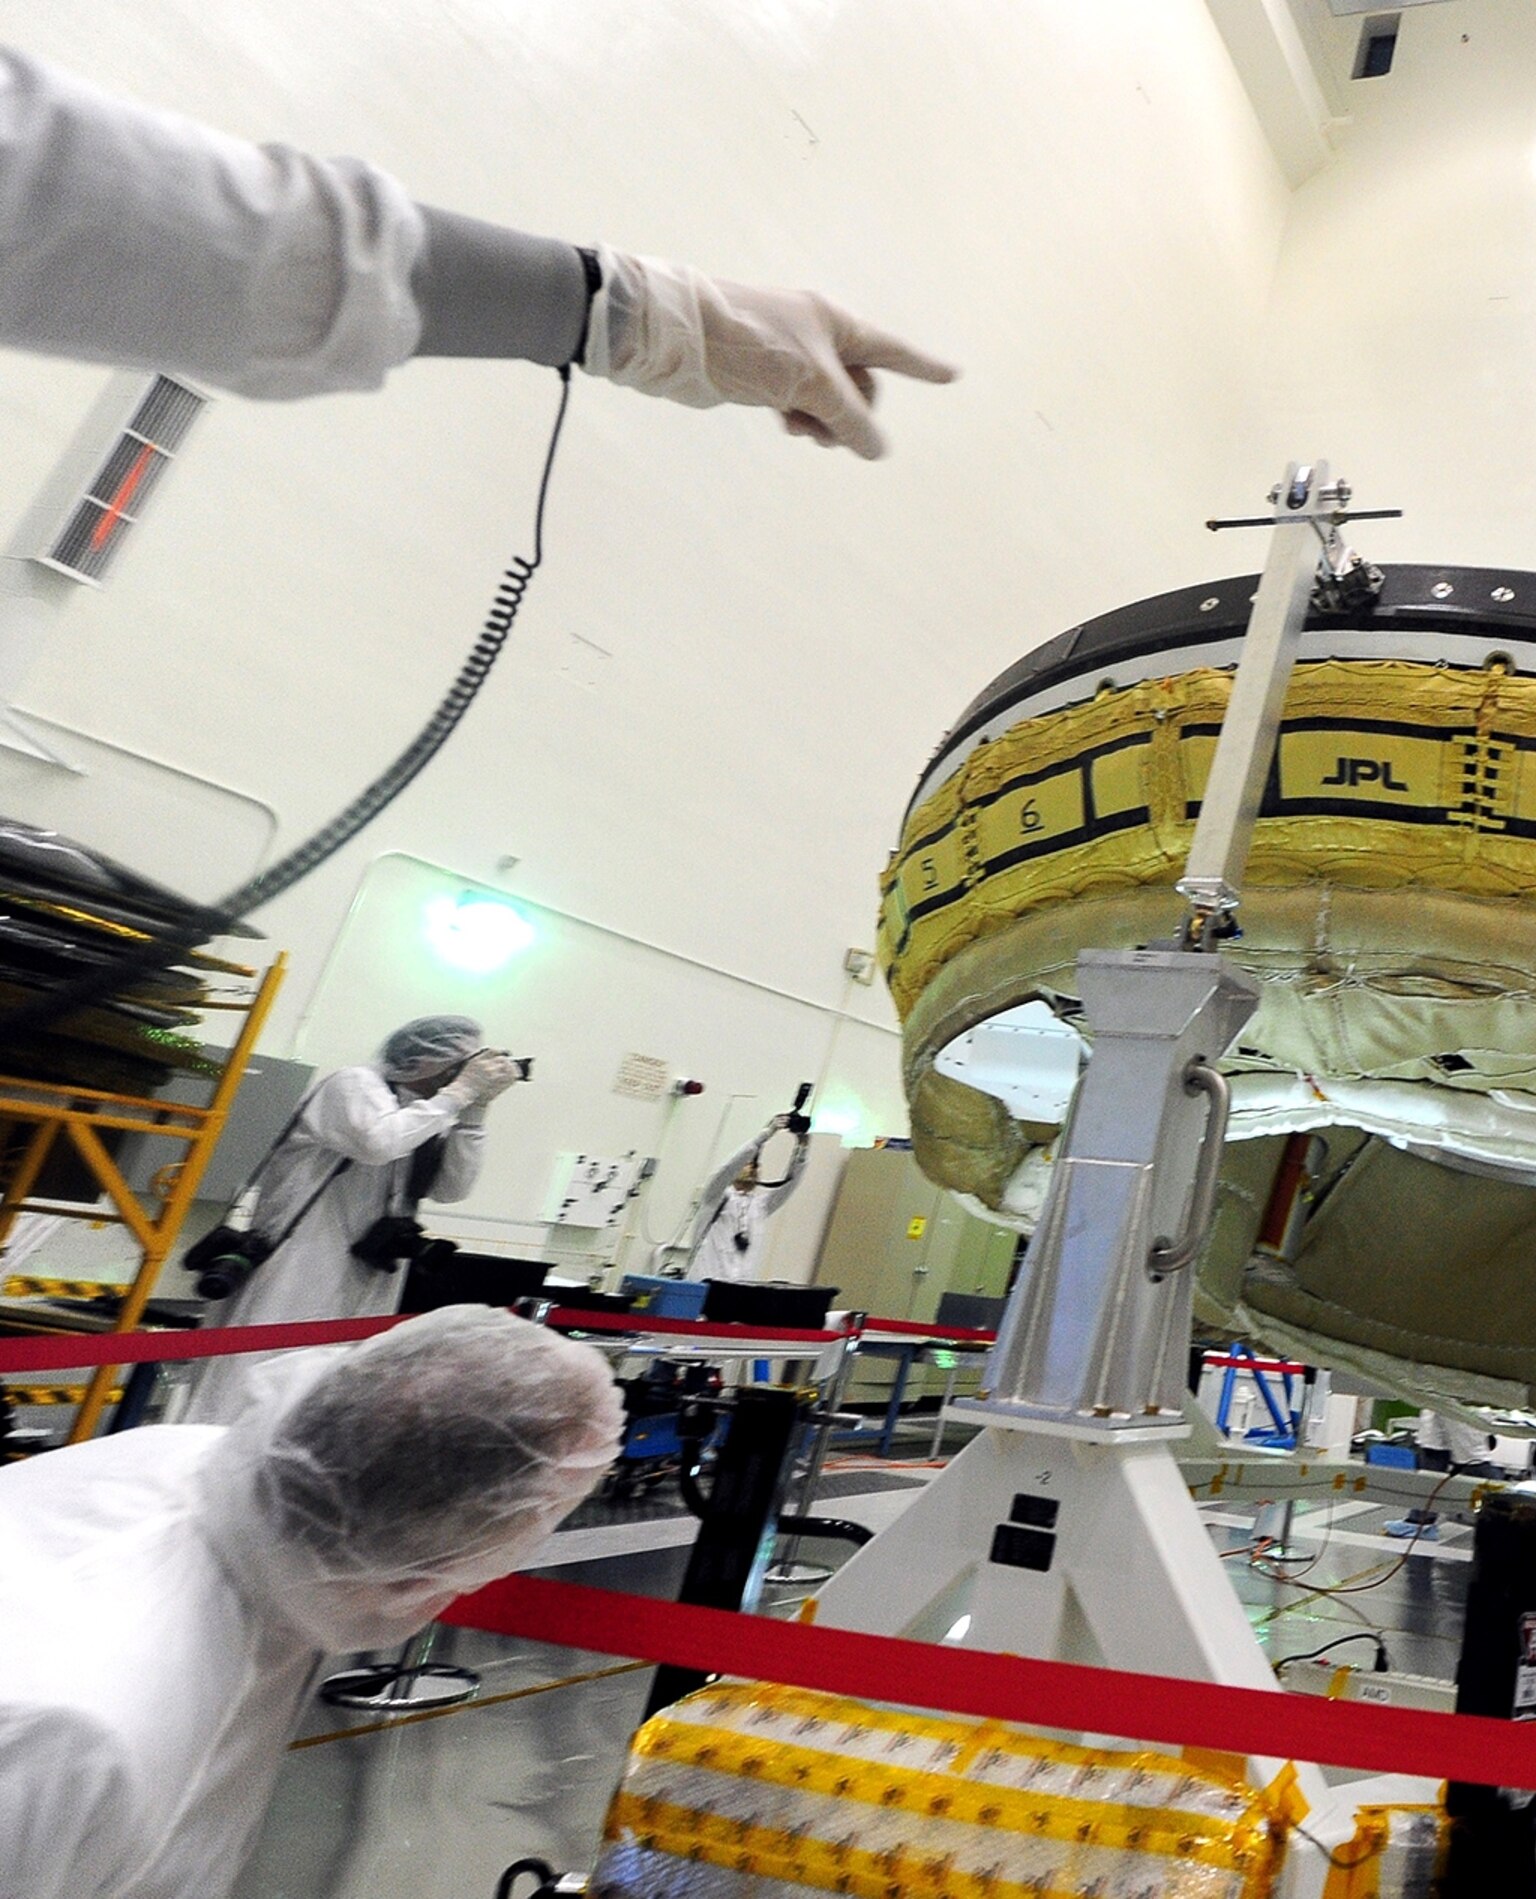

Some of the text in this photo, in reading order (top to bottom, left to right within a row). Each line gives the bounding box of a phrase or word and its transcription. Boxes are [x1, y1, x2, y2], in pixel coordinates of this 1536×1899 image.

[1321, 757, 1408, 792] JPL
[1020, 798, 1042, 831] 6
[921, 858, 939, 888] 5
